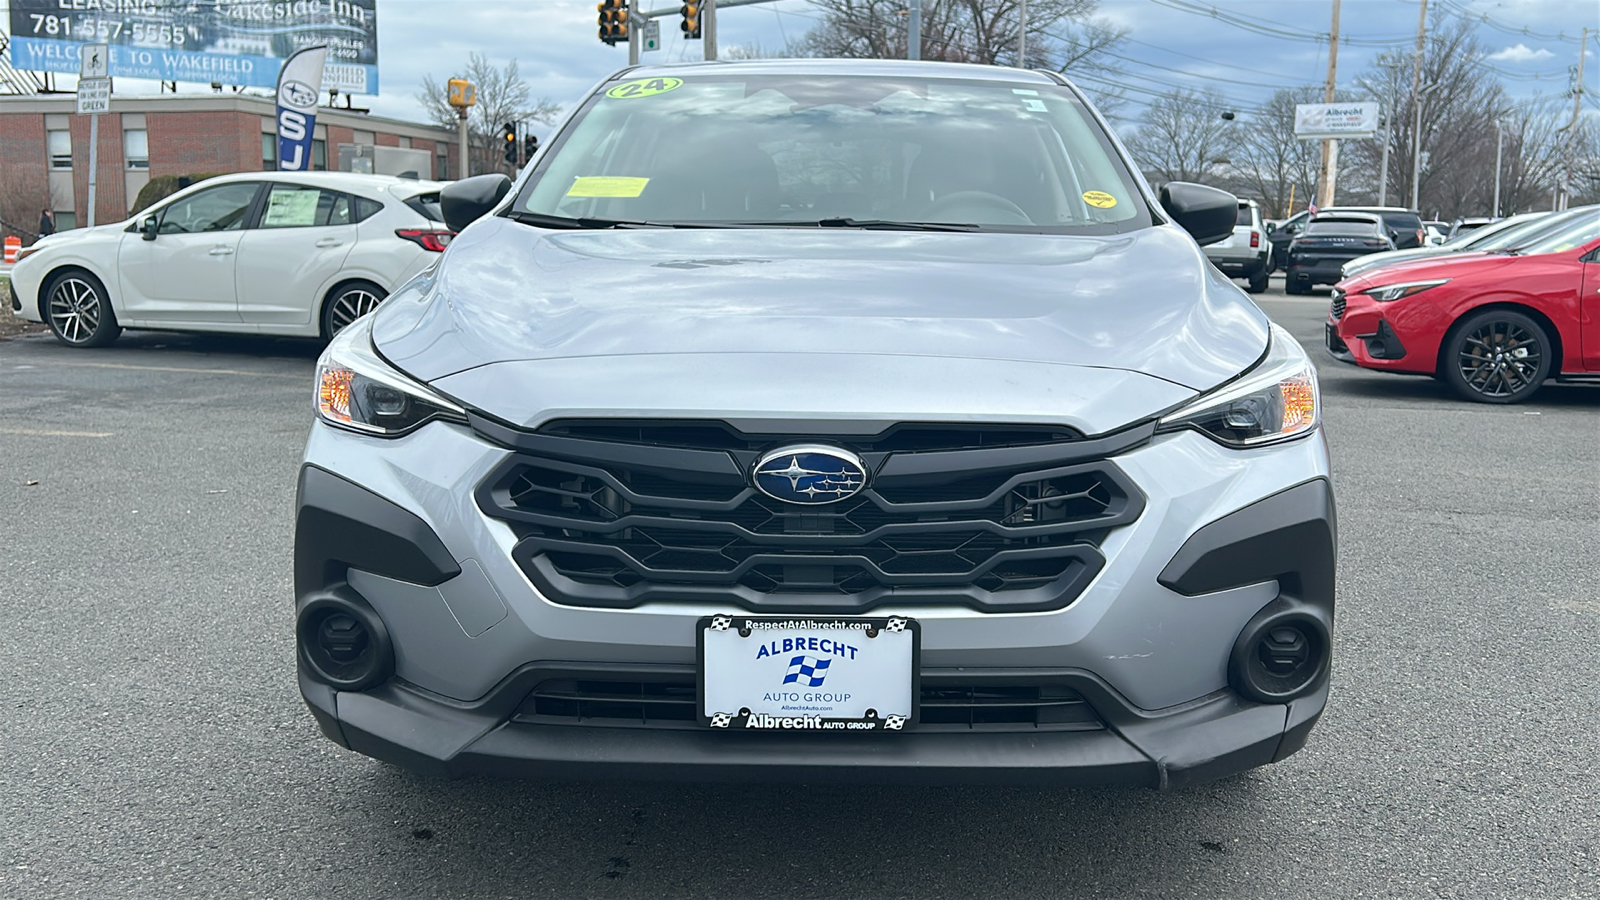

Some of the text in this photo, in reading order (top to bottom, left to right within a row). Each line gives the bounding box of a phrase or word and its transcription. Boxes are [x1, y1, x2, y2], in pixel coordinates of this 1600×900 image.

[58, 0, 156, 14] LEASING
[327, 0, 366, 23] Inn
[30, 13, 186, 45] 781-557-5555
[27, 42, 253, 74] WELCE TO WAKEFIELD
[620, 79, 668, 97] 24
[82, 101, 105, 110] GREEN
[745, 619, 872, 632] RespectAtAlbrecht.com
[756, 637, 858, 660] ALBRECHT
[763, 692, 852, 702] AUTO GROUP
[781, 704, 833, 712] AlbrechtAuto.com
[745, 713, 876, 731] Albrecht AUTO GROUP
